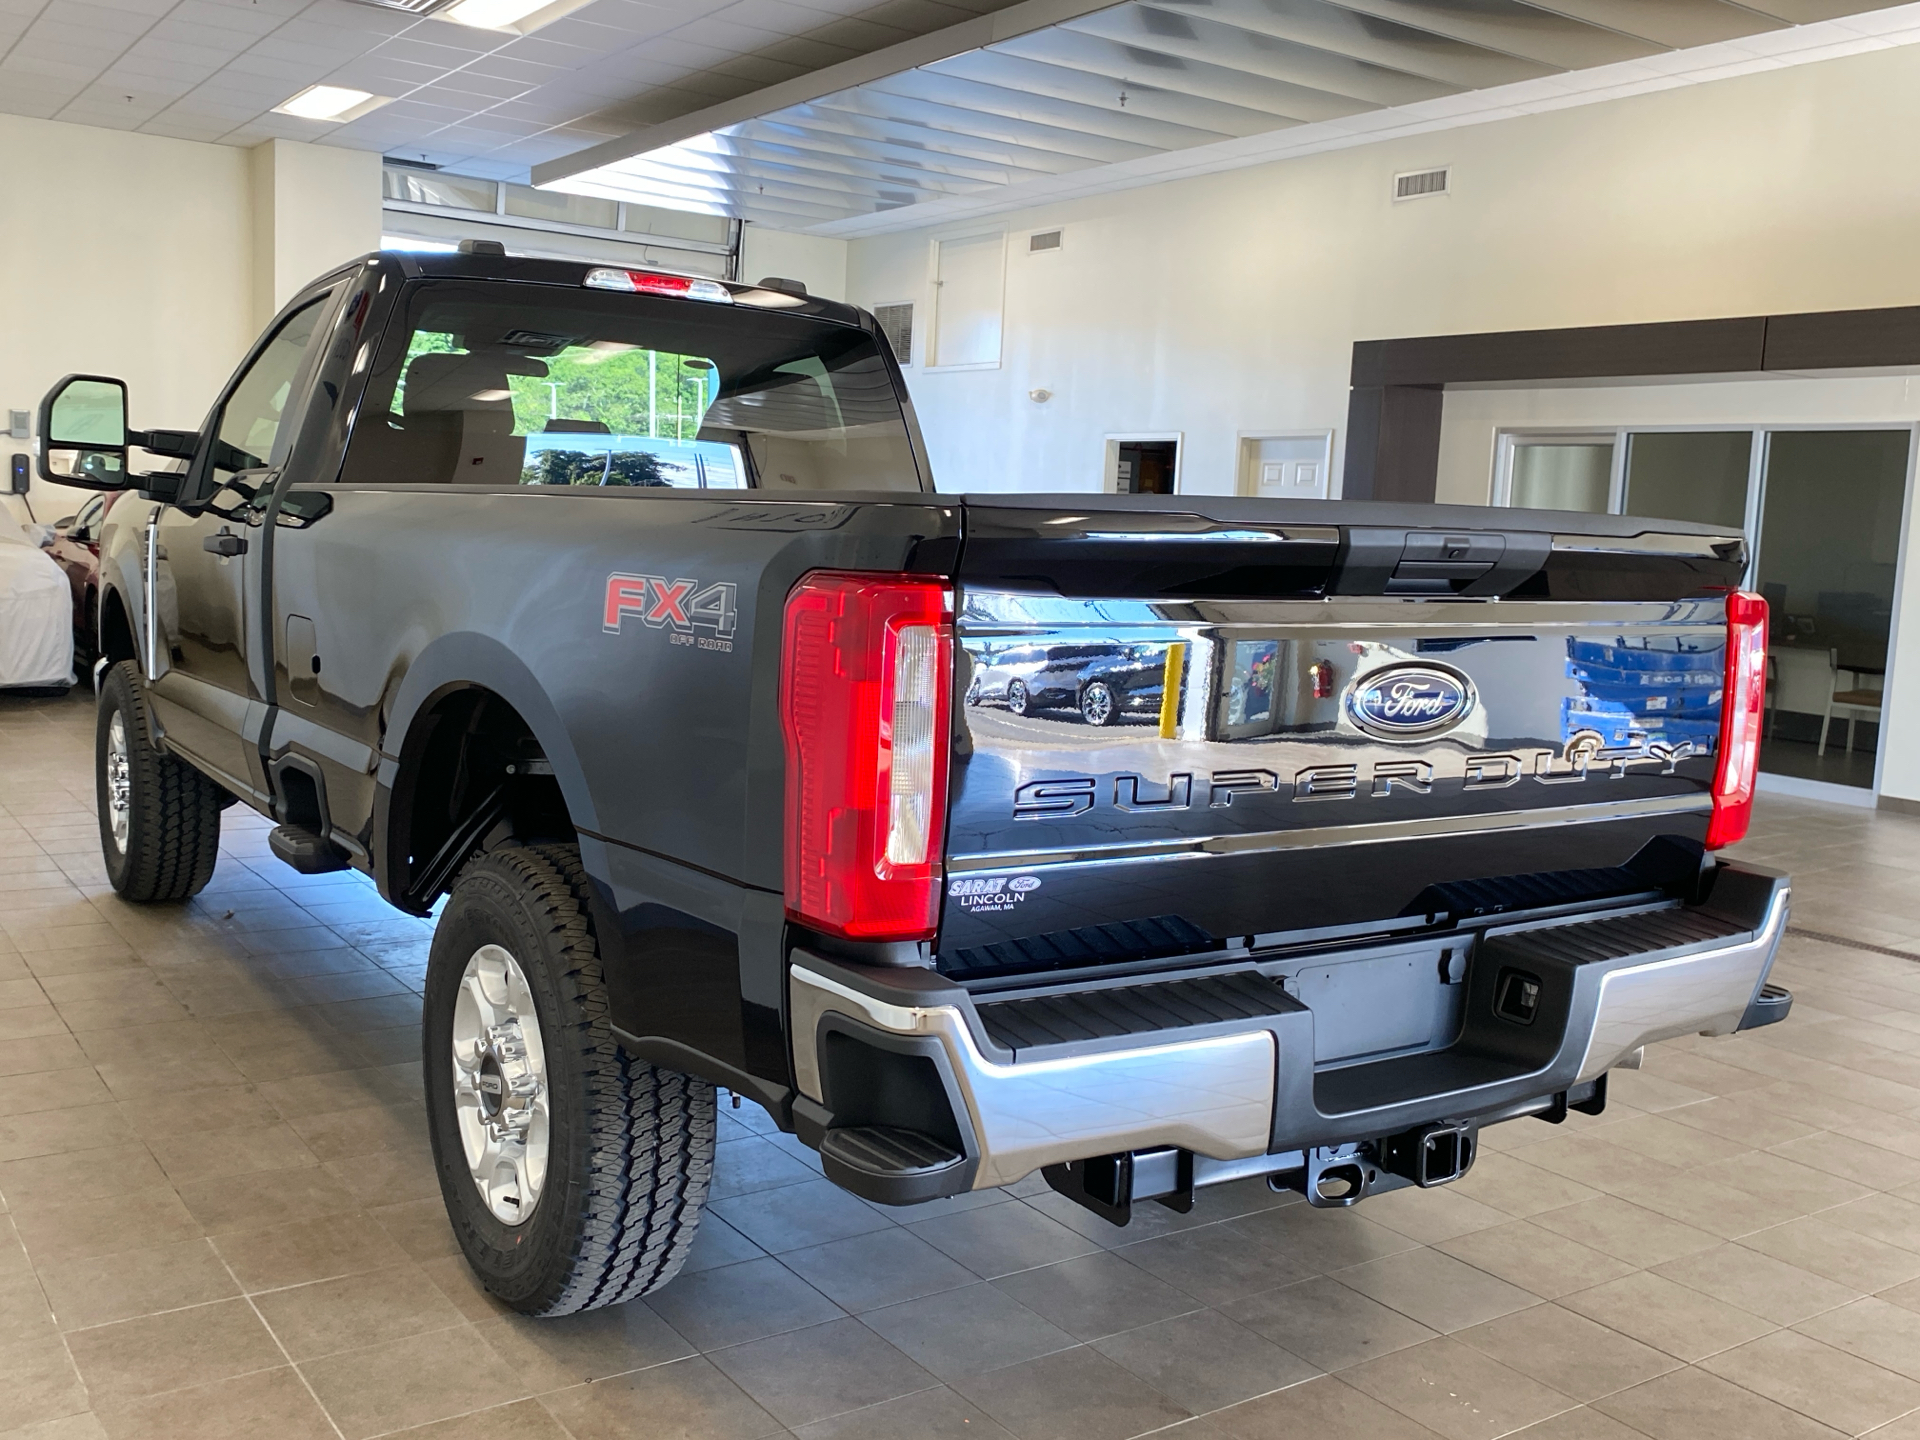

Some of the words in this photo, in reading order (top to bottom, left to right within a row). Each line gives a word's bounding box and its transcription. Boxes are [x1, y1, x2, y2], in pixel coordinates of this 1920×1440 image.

[602, 571, 737, 639] FX4
[669, 633, 695, 647] OFF
[697, 637, 734, 653] ROAD
[1384, 682, 1445, 717] Ford
[1013, 759, 1434, 820] SUPER
[1463, 741, 1694, 792] DUTY
[948, 877, 1007, 897] SARAT
[960, 892, 1025, 906] LINCOLN
[970, 904, 1002, 913] AGAWAM,
